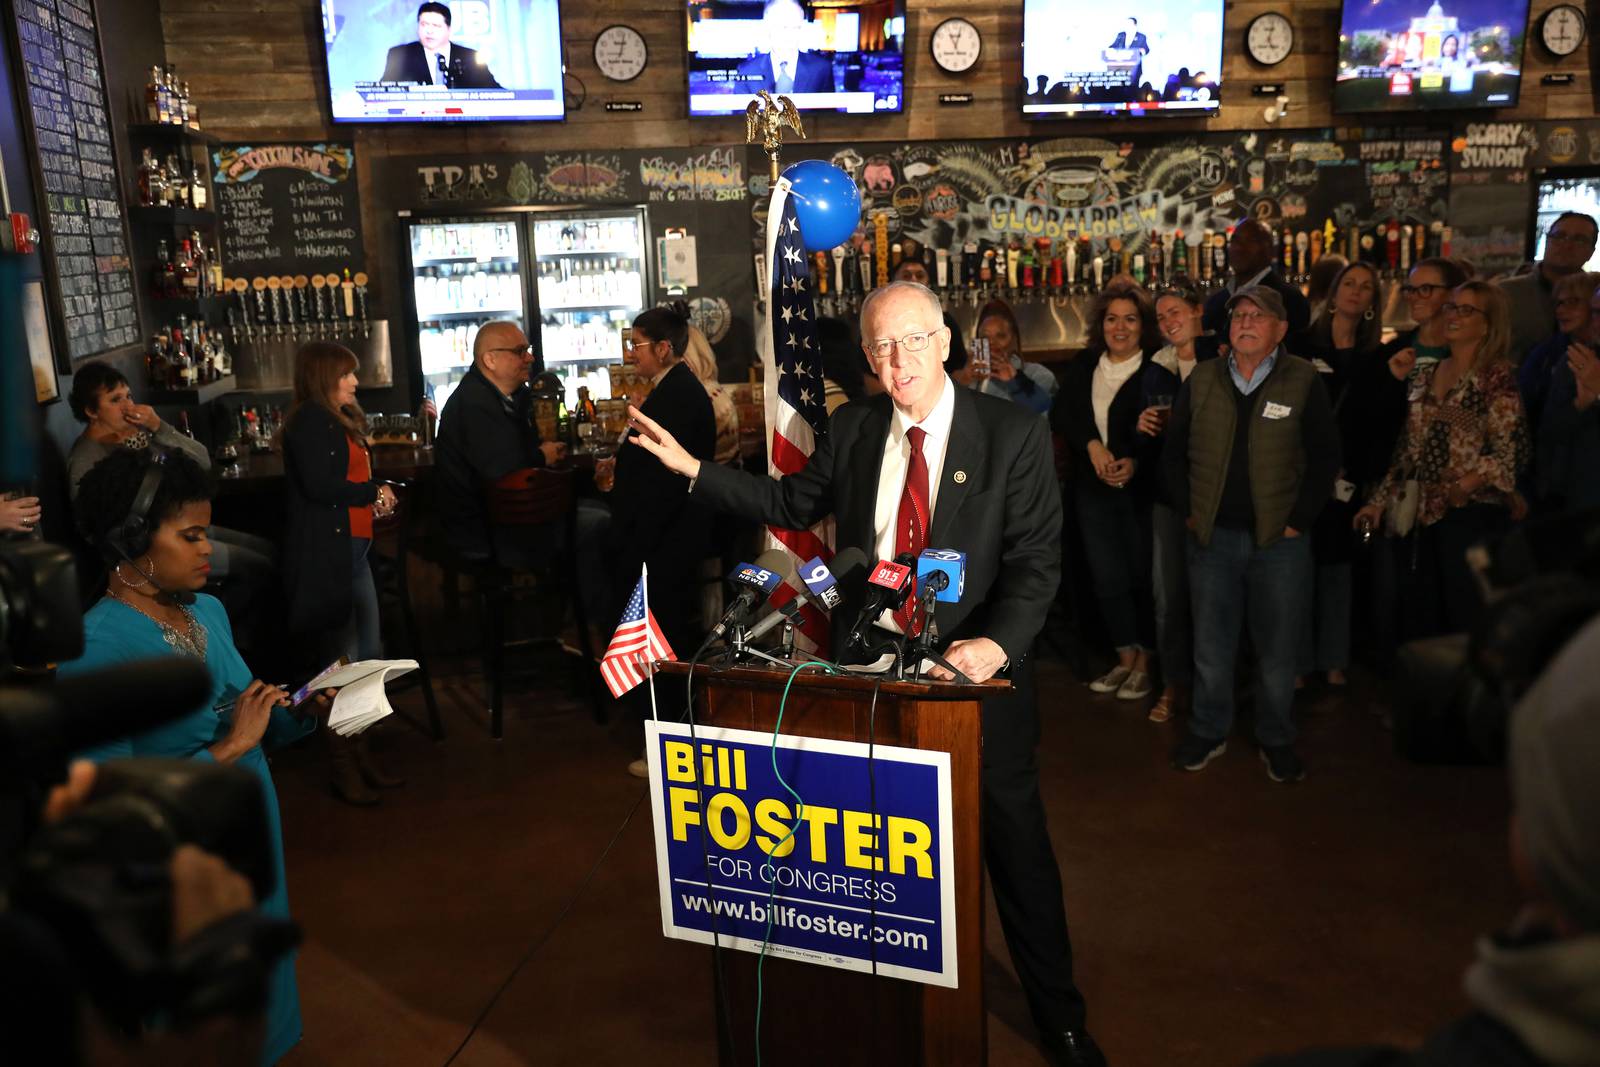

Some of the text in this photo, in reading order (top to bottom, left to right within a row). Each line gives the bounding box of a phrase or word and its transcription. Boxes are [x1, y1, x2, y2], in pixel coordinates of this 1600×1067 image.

[1467, 123, 1522, 146] SCARY
[1460, 146, 1528, 169] SUNDAY
[738, 574, 764, 586] NEWS
[755, 569, 772, 582] 5
[804, 564, 830, 584] 9
[878, 568, 900, 582] 91.5
[825, 585, 842, 607] WGN
[665, 740, 747, 790] Bill
[669, 786, 934, 880] FOSTER
[706, 854, 896, 903] FOR CONGRESS
[682, 894, 928, 951] www.billfoster.com
